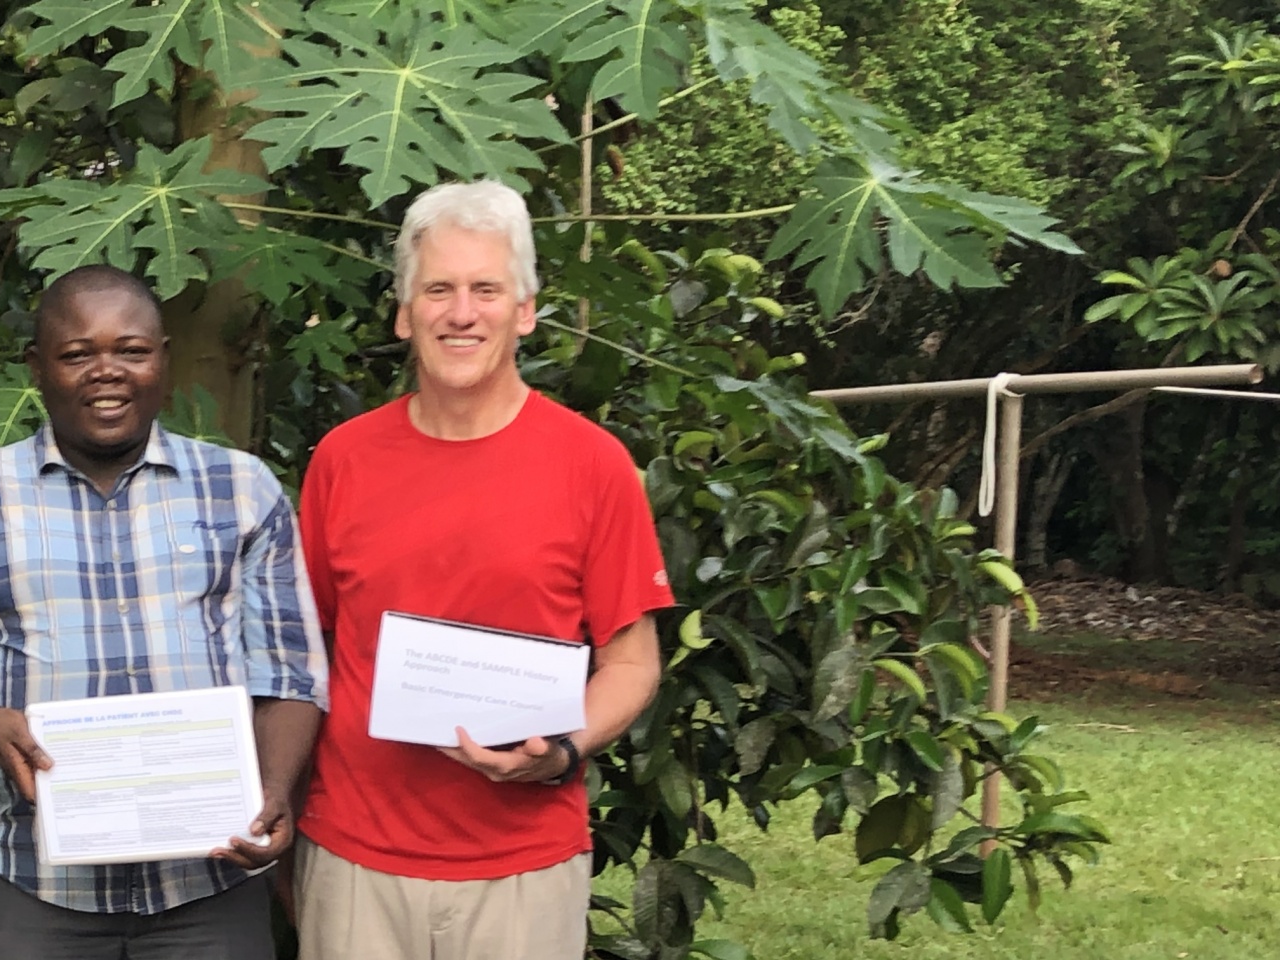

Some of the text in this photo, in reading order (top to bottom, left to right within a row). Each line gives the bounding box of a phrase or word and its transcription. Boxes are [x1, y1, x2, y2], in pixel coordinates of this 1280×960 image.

[403, 660, 451, 676] Approach
[405, 649, 424, 660] The
[460, 659, 480, 670] and
[481, 662, 522, 677] SAMPLE
[523, 669, 559, 685] History
[401, 681, 544, 712] Basic Emergency Care Course
